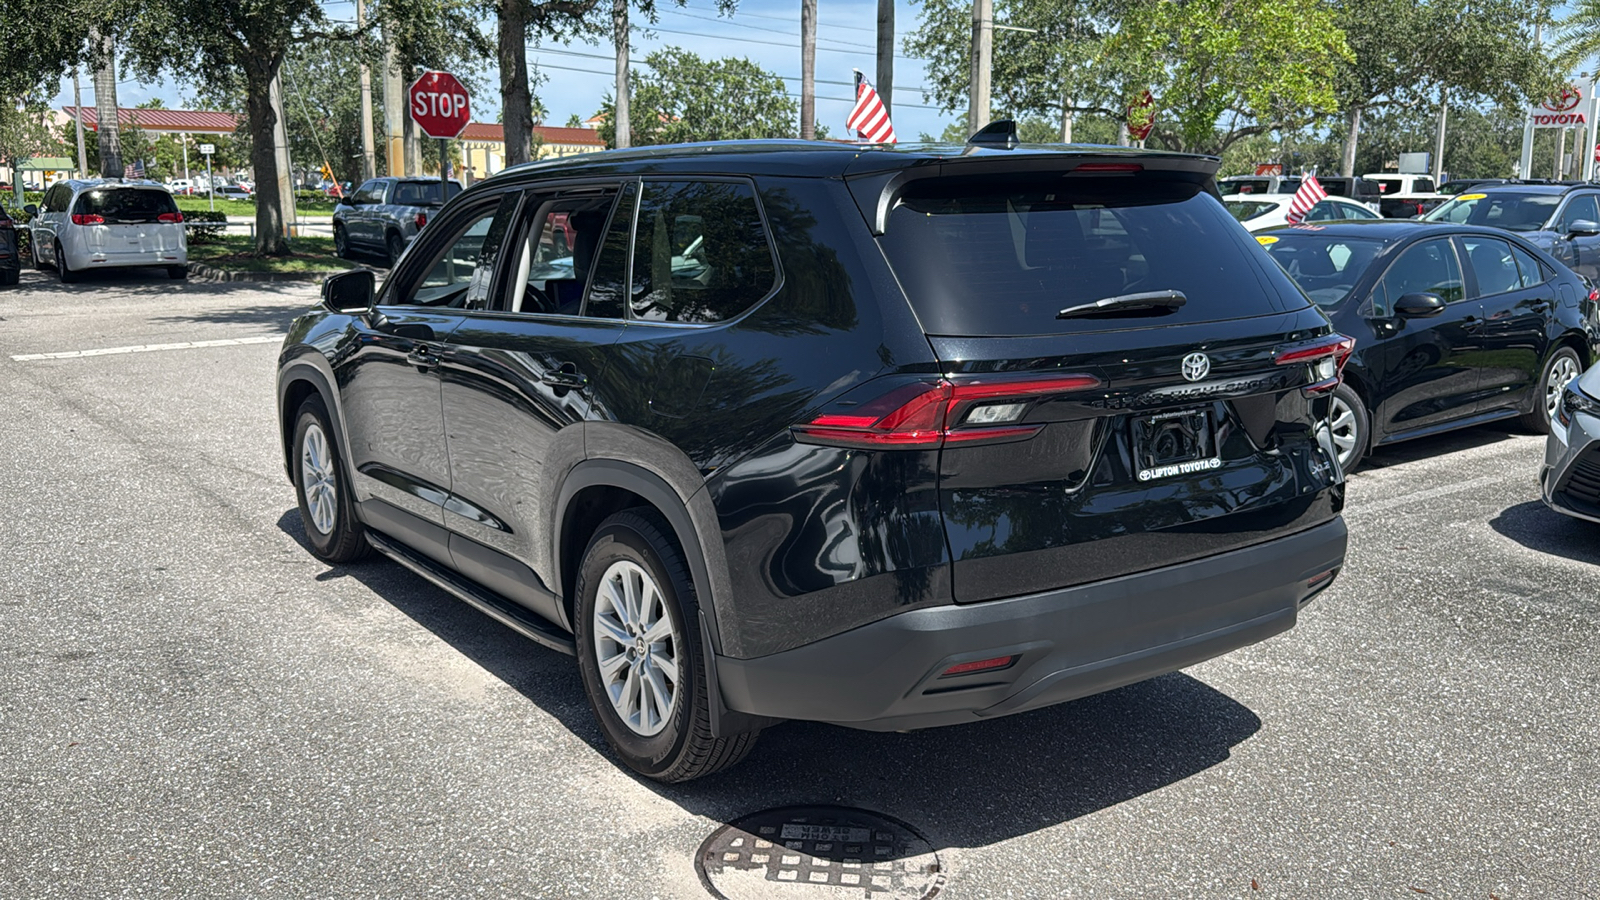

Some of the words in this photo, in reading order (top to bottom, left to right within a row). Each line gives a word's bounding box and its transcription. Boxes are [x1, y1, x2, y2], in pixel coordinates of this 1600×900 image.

[415, 92, 466, 118] STOP
[1533, 113, 1586, 125] TOYOTA
[1151, 466, 1179, 479] LIPTON
[1180, 460, 1210, 474] TOYOTA
[675, 664, 685, 730] MICHELIN
